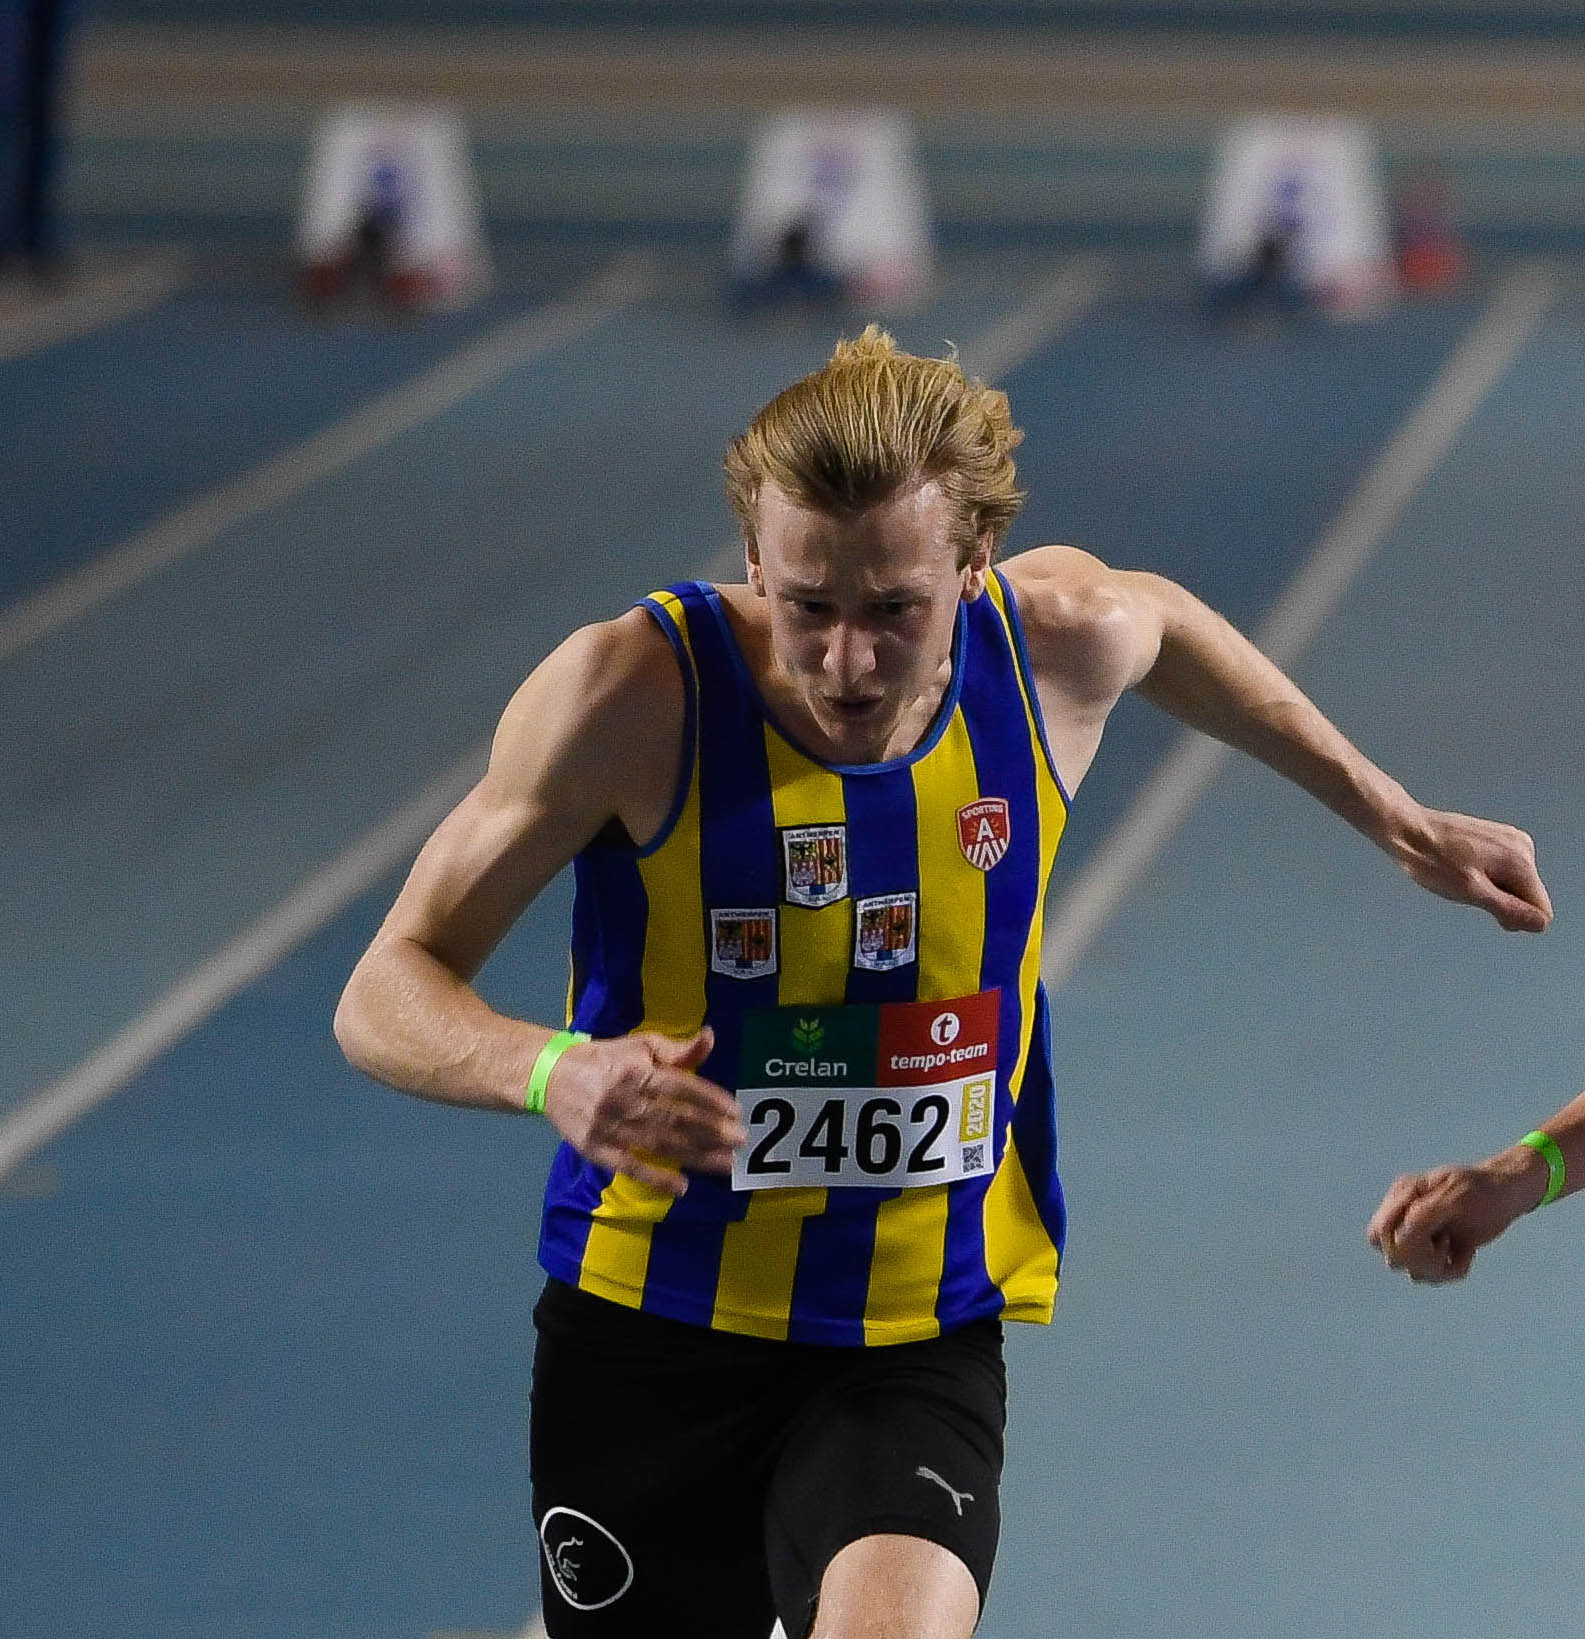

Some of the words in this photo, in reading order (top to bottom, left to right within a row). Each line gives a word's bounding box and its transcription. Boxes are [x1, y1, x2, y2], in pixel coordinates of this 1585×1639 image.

[764, 1057, 848, 1077] Crelan
[890, 1042, 988, 1073] tempo-team
[966, 1085, 985, 1134] 2020
[747, 1092, 950, 1175] 2462
